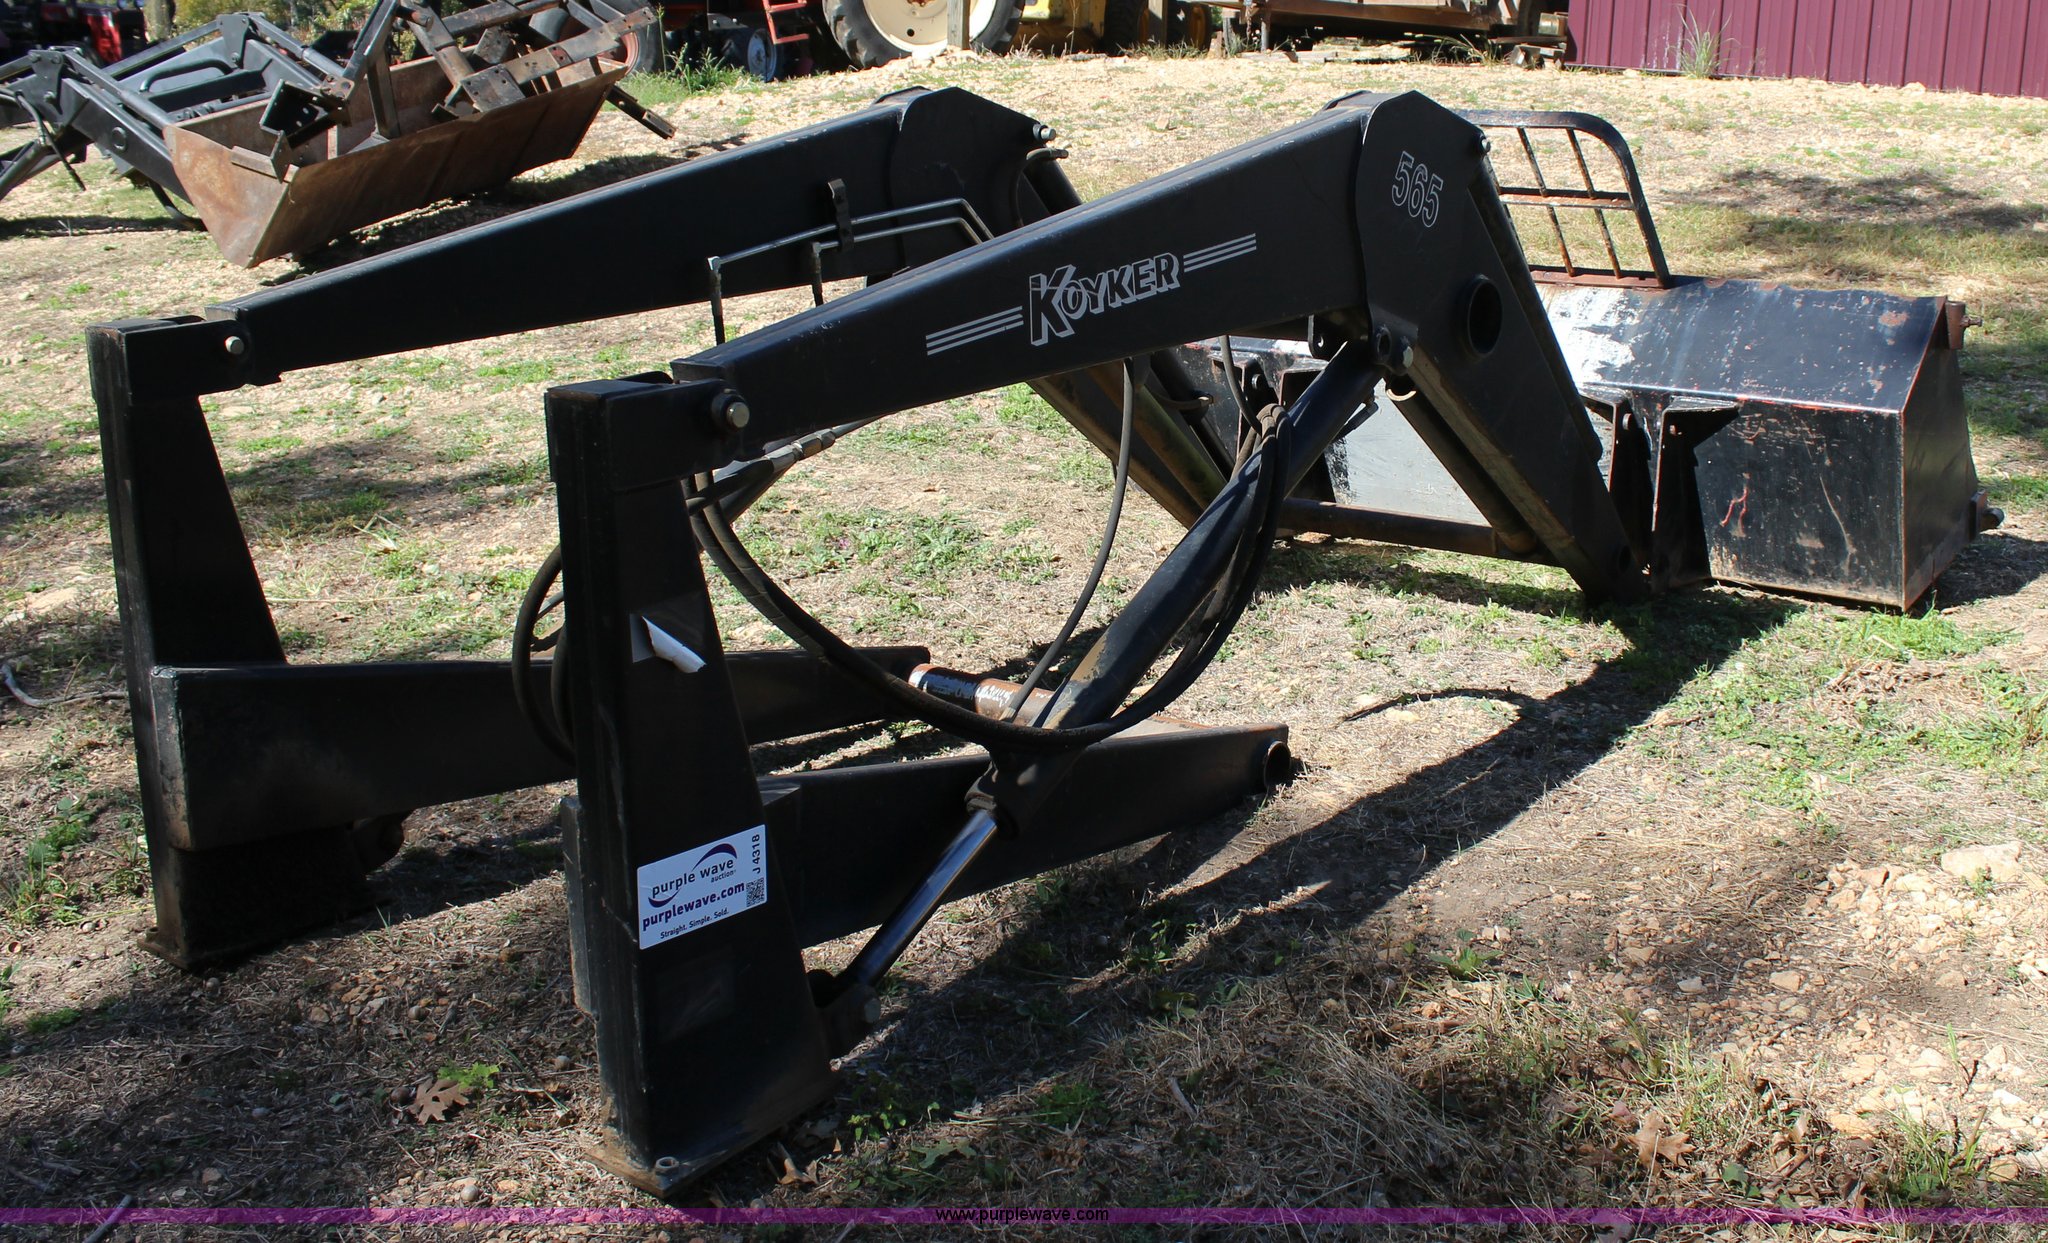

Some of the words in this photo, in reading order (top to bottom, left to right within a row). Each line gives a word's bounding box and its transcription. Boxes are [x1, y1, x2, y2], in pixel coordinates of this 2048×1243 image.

[1391, 150, 1444, 228] 565
[1029, 252, 1180, 346] KOYKER
[751, 834, 761, 864] 4318
[651, 871, 696, 899] purple
[699, 858, 734, 879] wave
[642, 882, 745, 931] purplewave.com
[660, 924, 688, 939] Straight.
[688, 915, 712, 929] Simple.
[713, 907, 730, 919] Sold.
